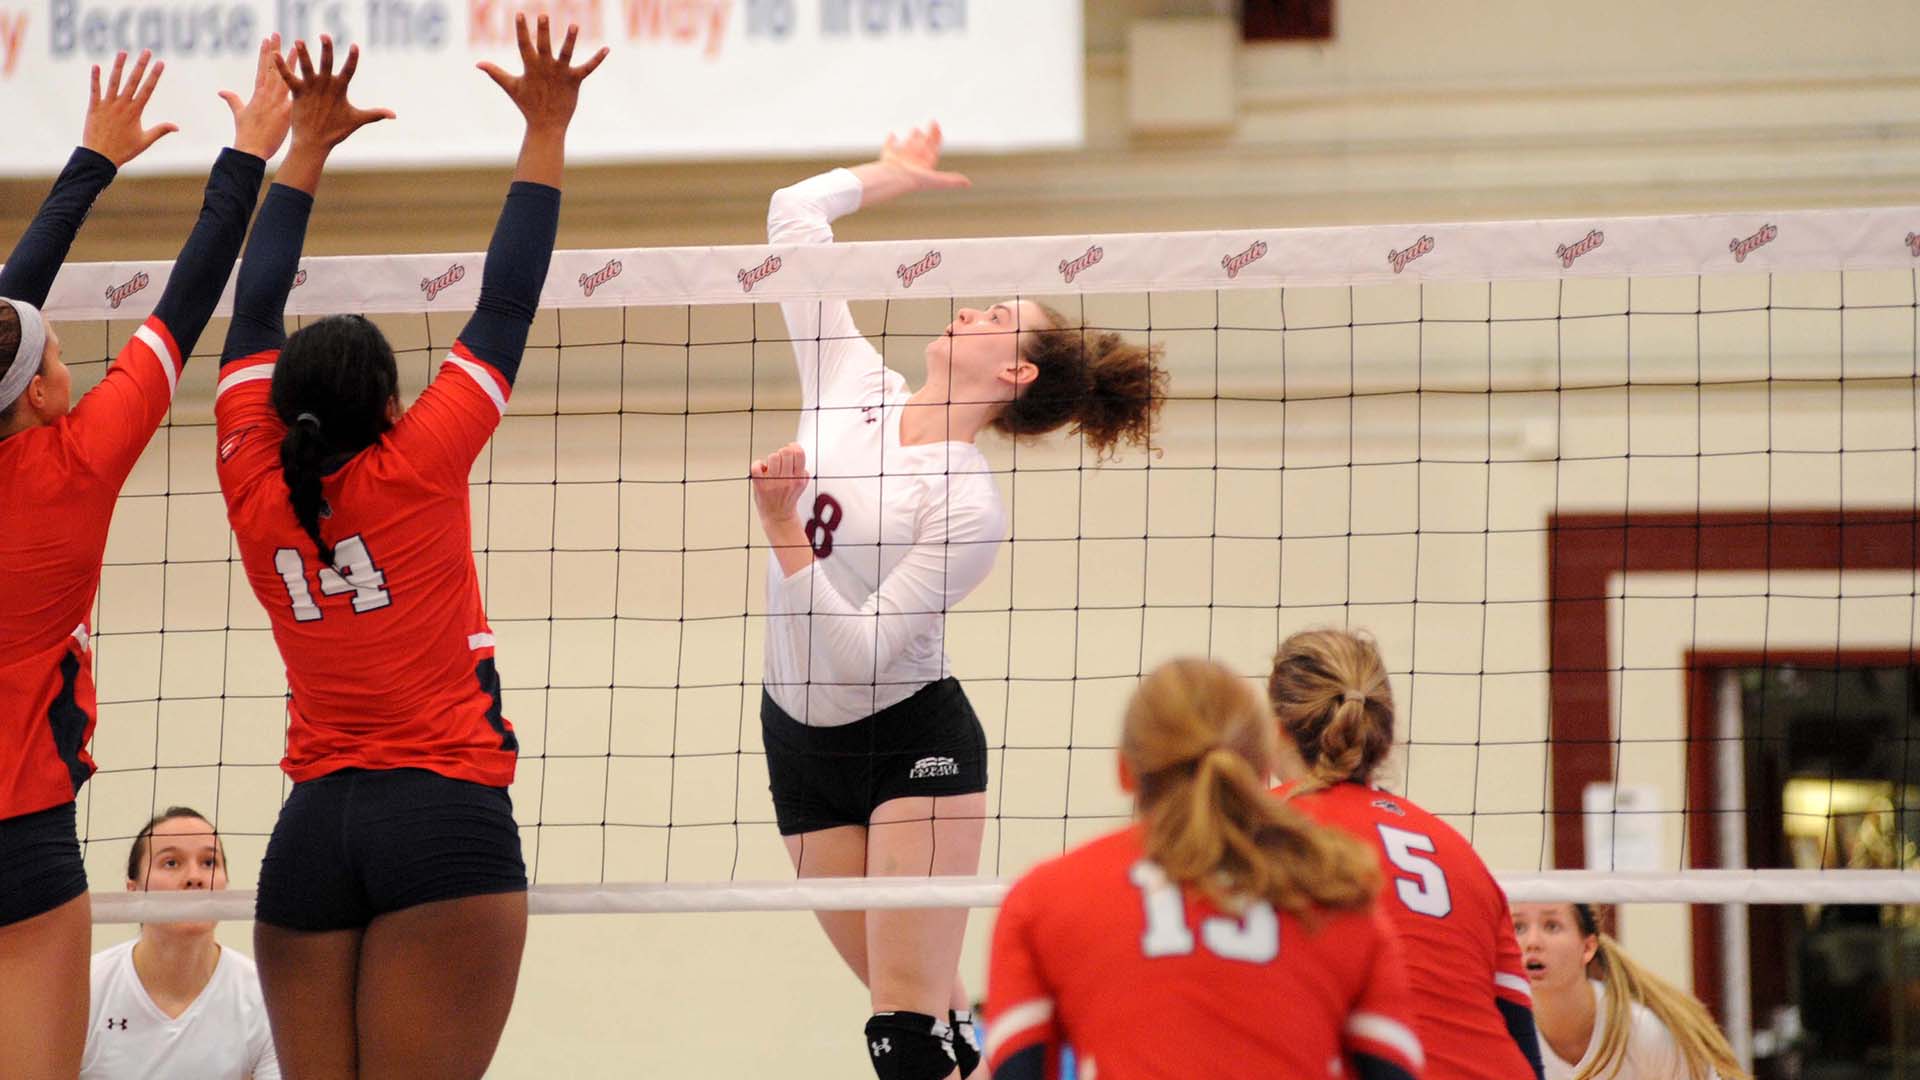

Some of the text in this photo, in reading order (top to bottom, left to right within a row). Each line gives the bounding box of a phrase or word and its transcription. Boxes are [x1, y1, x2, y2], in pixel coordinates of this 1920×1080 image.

[51, 0, 253, 57] Because
[367, 0, 448, 49] the
[618, 0, 735, 60] Way
[745, 0, 796, 39] to
[804, 492, 843, 560] 8
[273, 532, 392, 623] 14
[1376, 823, 1452, 919] 5
